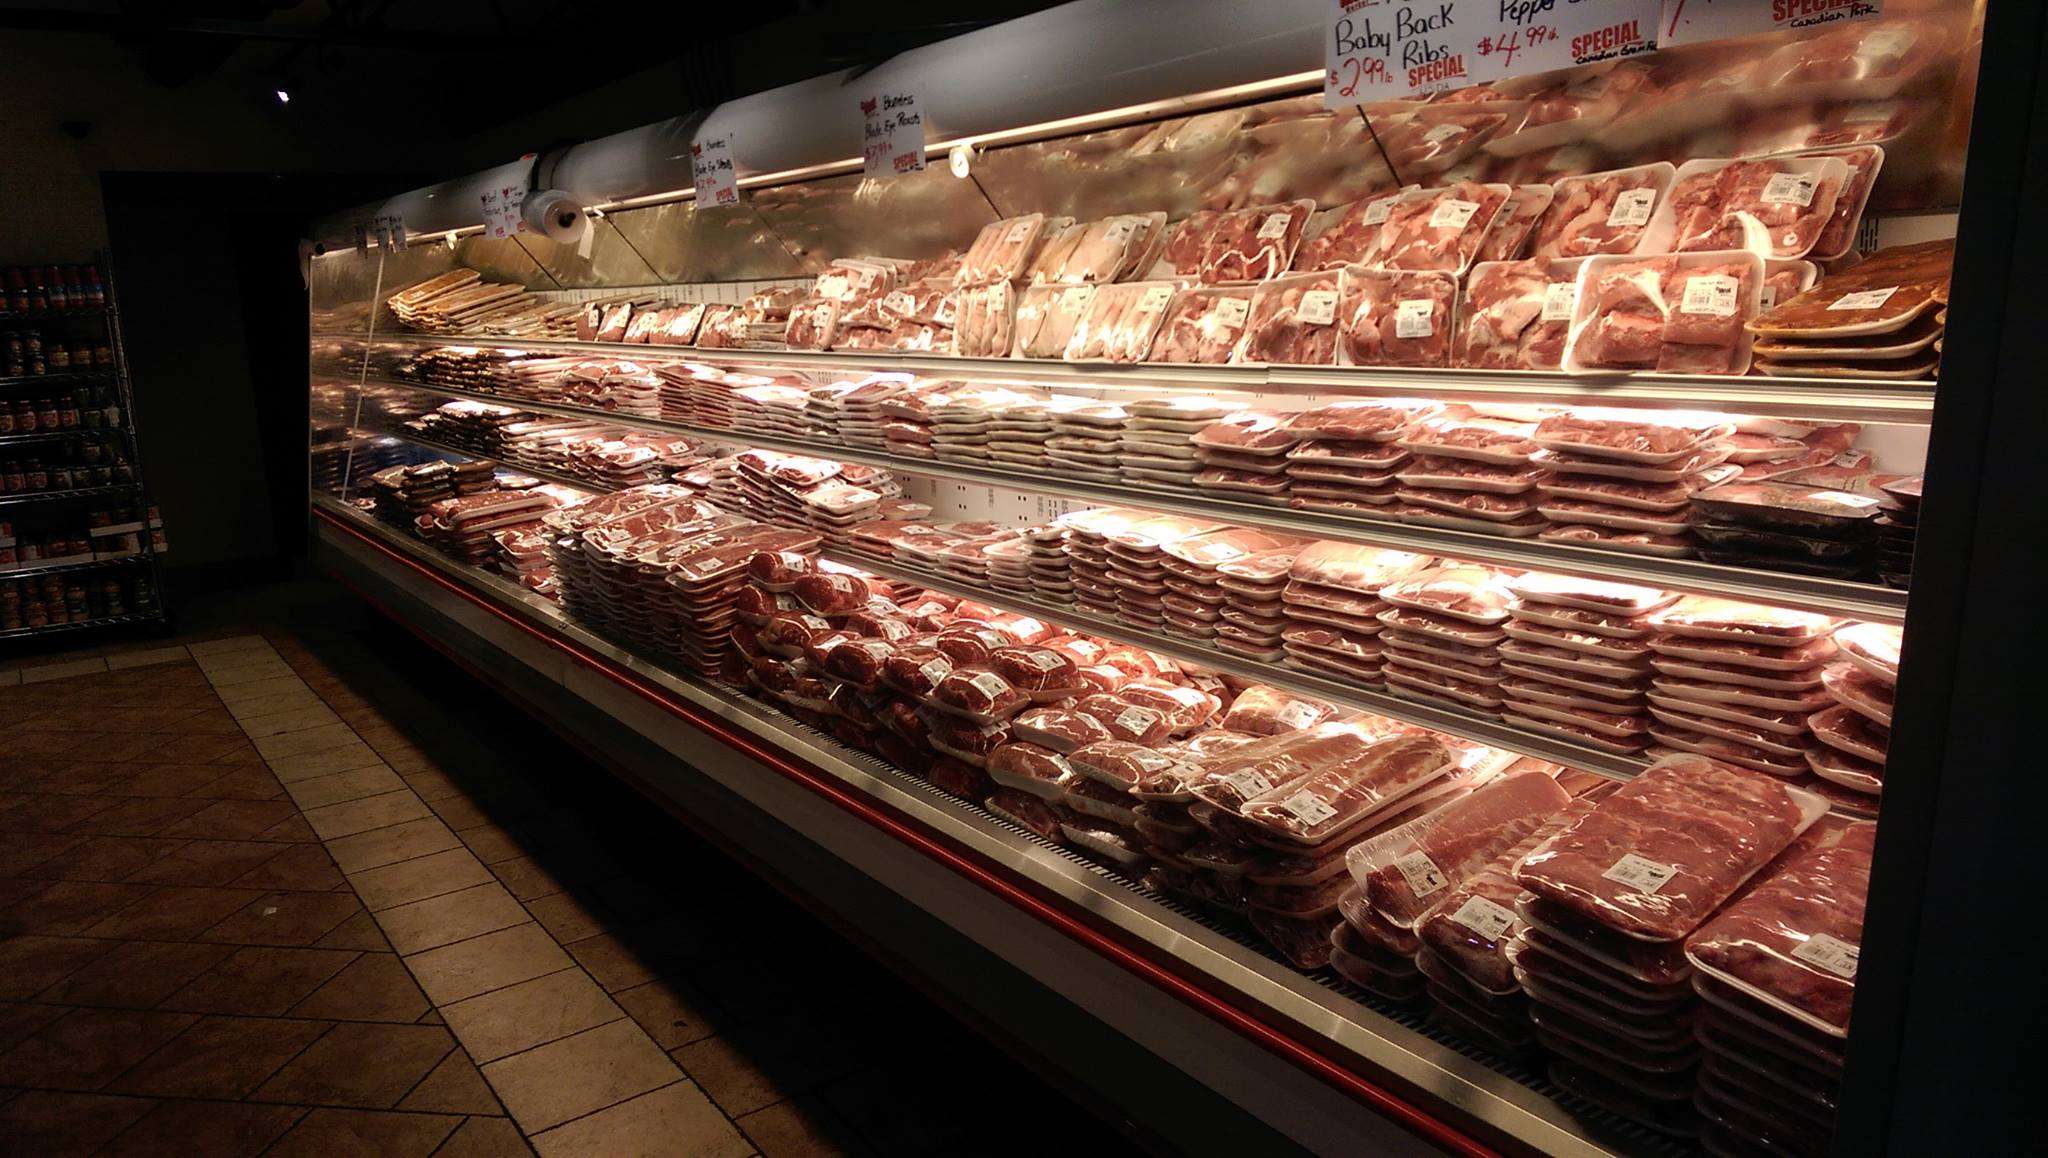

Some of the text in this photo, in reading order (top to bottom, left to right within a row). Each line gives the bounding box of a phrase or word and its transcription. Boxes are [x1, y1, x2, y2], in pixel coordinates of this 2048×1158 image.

[1499, 0, 1555, 25] Peppe
[1791, 12, 1845, 28] Canadian
[1335, 3, 1454, 56] Baby Back
[1571, 20, 1641, 58] SPECIAL
[1403, 40, 1449, 69] Ribs
[1408, 54, 1466, 88] SPECIAL
